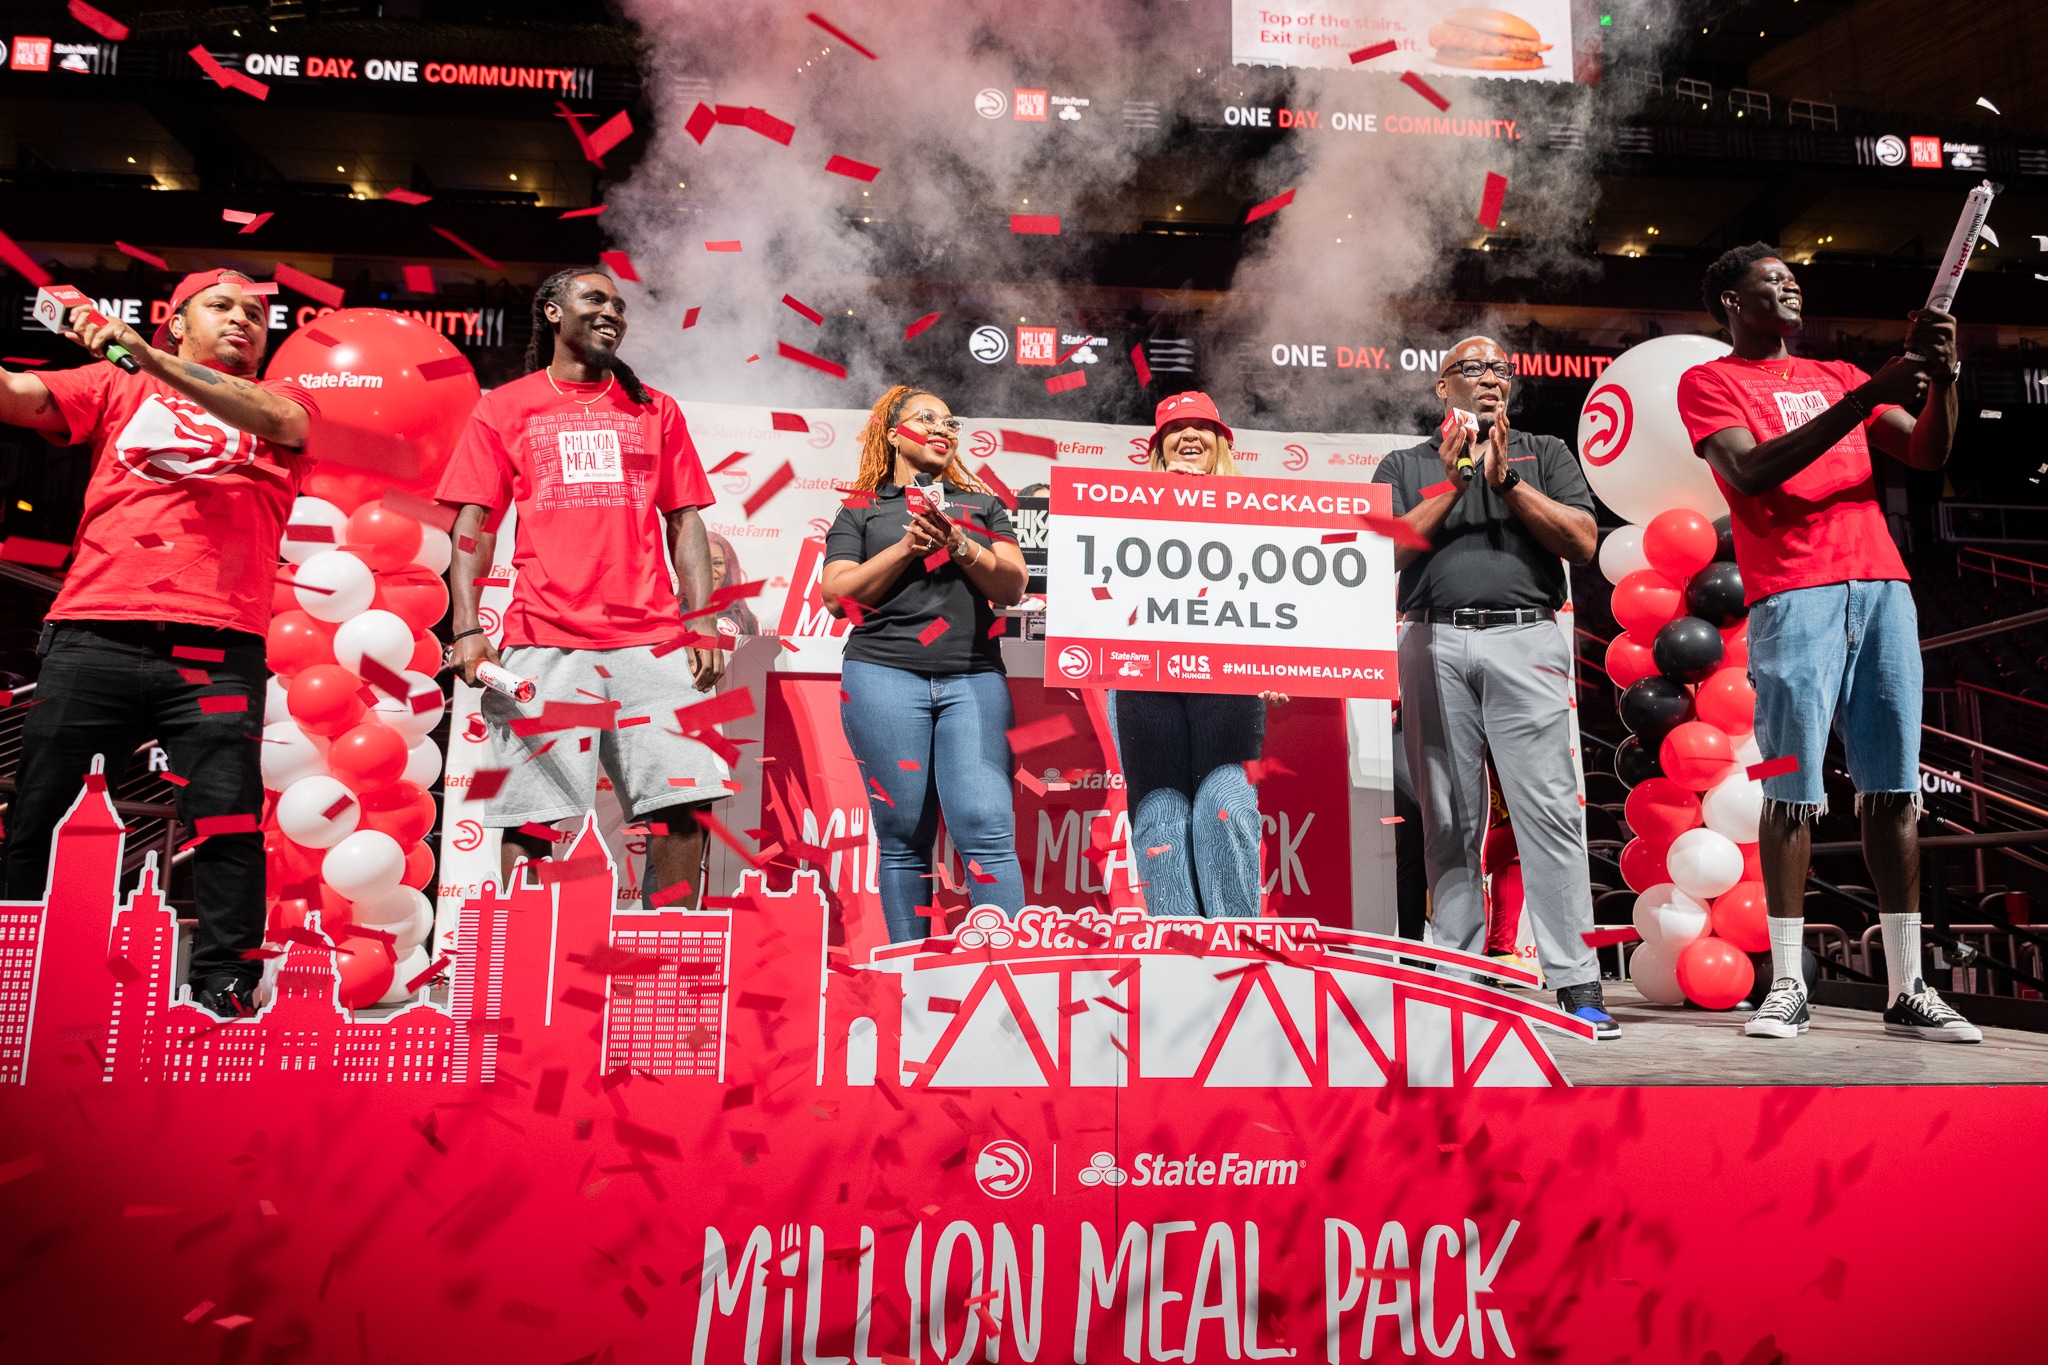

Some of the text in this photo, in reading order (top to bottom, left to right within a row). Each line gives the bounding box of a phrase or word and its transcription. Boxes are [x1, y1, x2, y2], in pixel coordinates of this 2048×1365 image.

[1259, 11, 1407, 32] Top of the stairs.
[1260, 29, 1292, 44] Exit
[1298, 31, 1357, 49] right...
[245, 53, 577, 90] ONE DAY. ONE COMMUNITY.
[1224, 106, 1521, 140] ONE DAY. ONE COMMUNITY.
[1950, 213, 1984, 277] blast! CANNON
[1271, 344, 1327, 368] ONE
[1337, 347, 1391, 370] DAY.
[1779, 393, 1824, 411] MILLION
[564, 433, 614, 452] MILLION
[566, 452, 602, 472] MEAL
[1072, 482, 1371, 515] TODAY WE PACKAGED
[1076, 534, 1368, 590] 1,000,000
[1147, 596, 1299, 630] MEALS
[1110, 651, 1150, 662] StateFarm
[1222, 663, 1385, 681] #MILLIONMEALPACK
[1034, 809, 1142, 894] MEA
[1210, 923, 1322, 952] ARENA
[1131, 1152, 1299, 1186] StateFarm
[1074, 1220, 1297, 1364] MEAL
[1324, 1217, 1521, 1365] PACK
